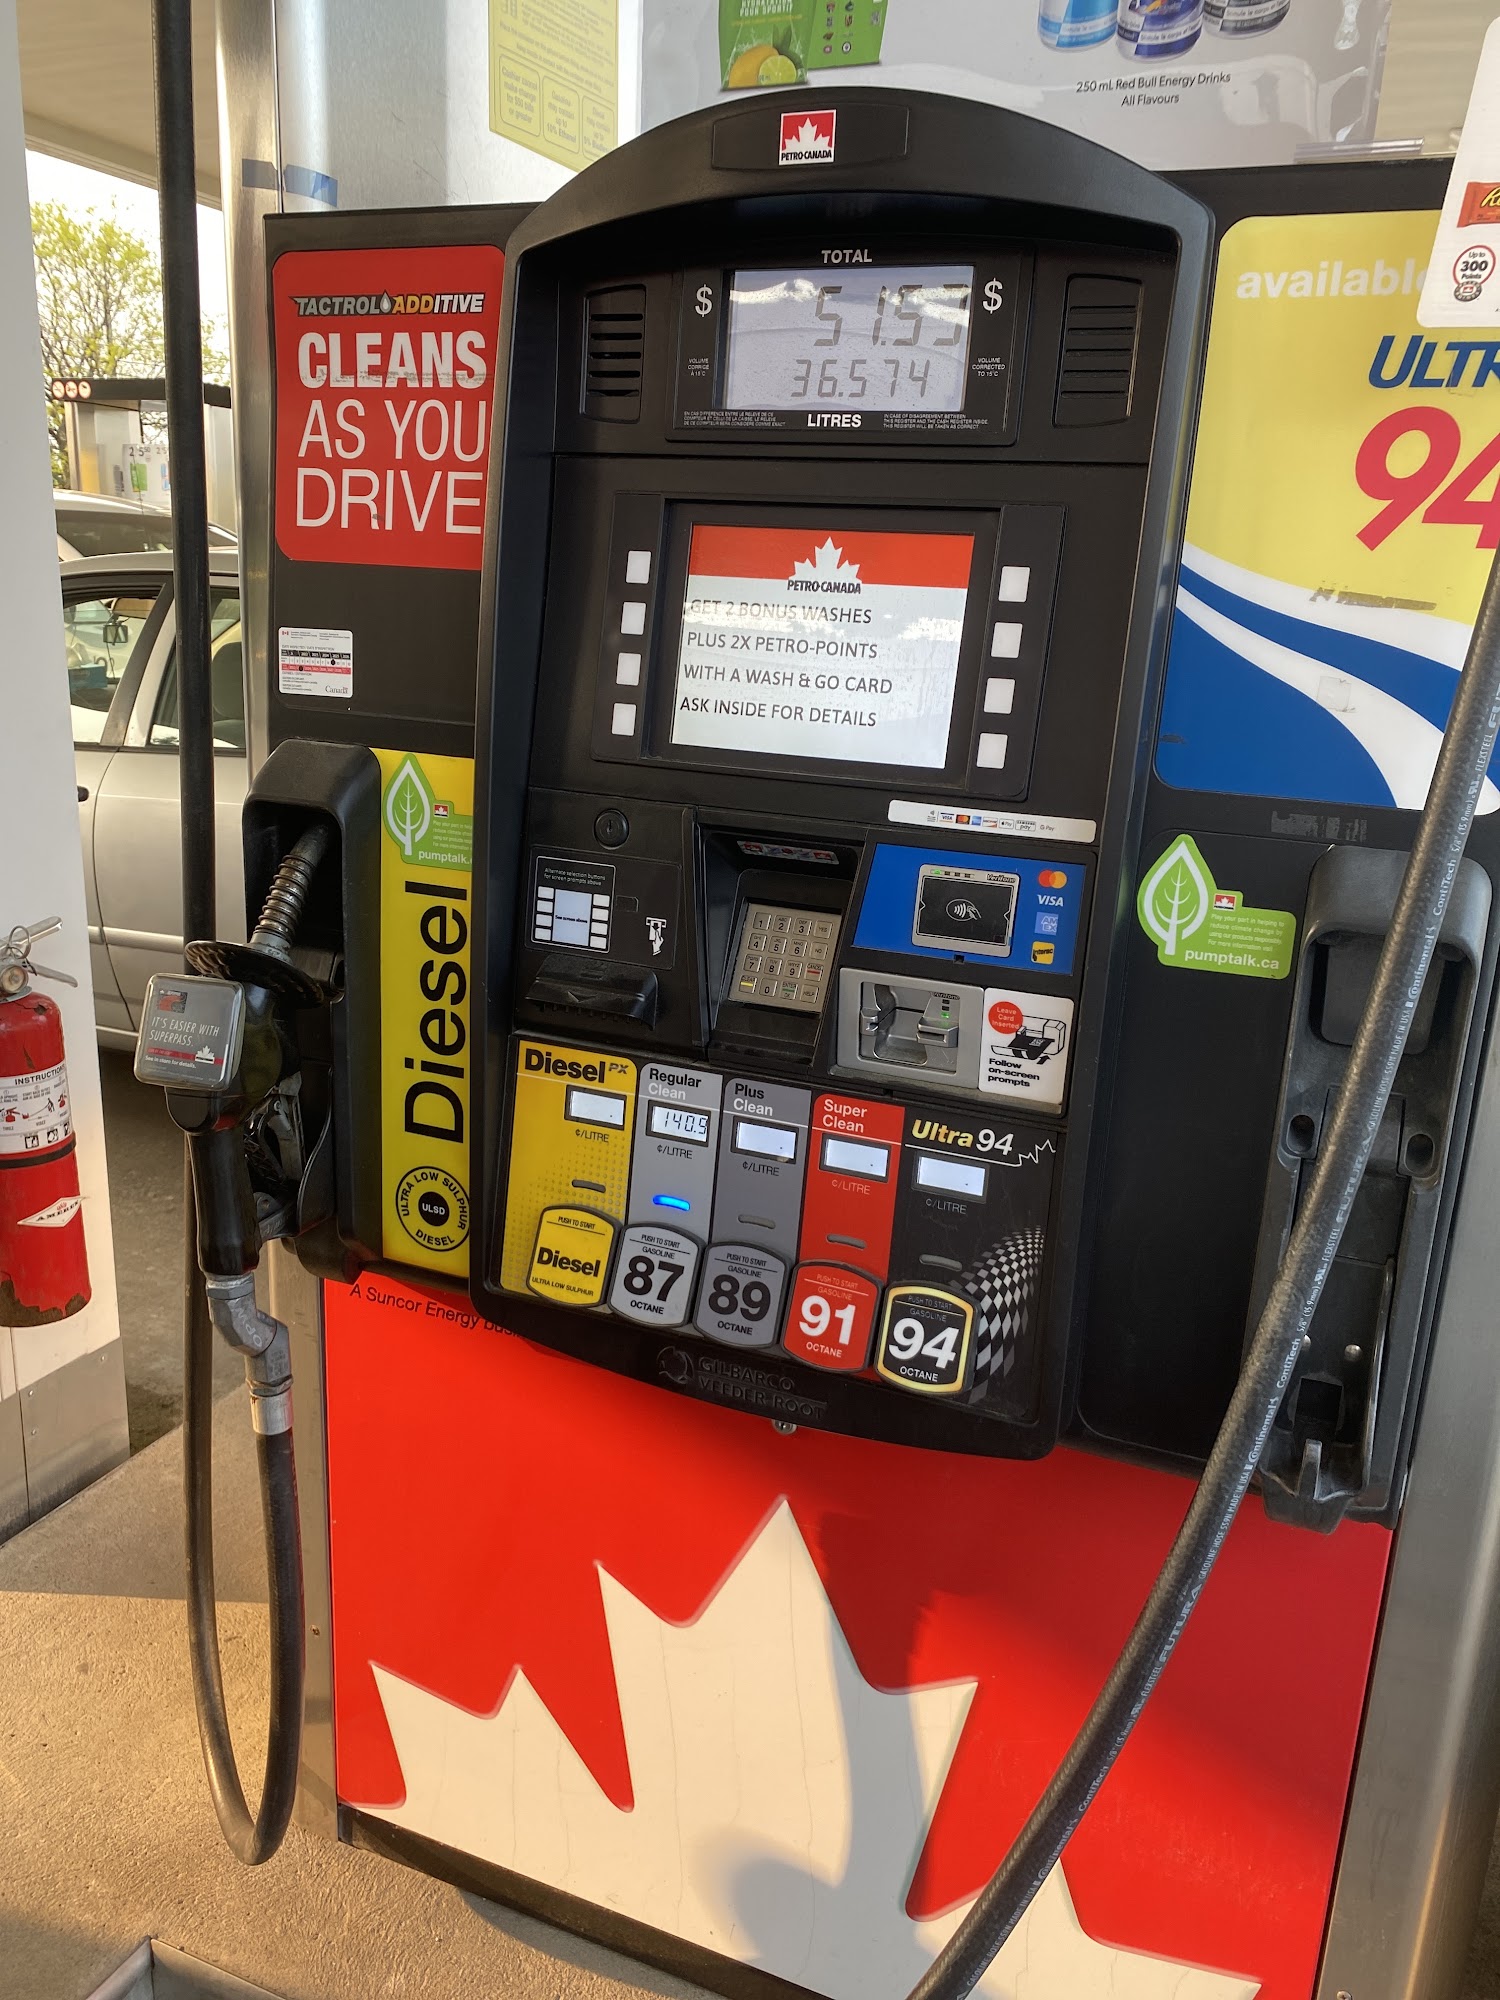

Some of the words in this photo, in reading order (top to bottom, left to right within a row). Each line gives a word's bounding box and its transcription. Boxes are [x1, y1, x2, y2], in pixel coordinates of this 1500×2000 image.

[1076, 80, 1097, 93] 250
[1099, 80, 1113, 92] mL
[1115, 78, 1136, 90] Red
[1137, 76, 1157, 88] Bull
[1159, 75, 1195, 88] Energy
[1197, 71, 1231, 85] Drinks
[1121, 95, 1135, 107] All
[1137, 93, 1180, 105] Flavours
[821, 249, 873, 264] TOTAL
[1460, 260, 1489, 272] 300
[294, 297, 380, 316] TACTROL
[392, 293, 485, 314] ADDITIVE
[694, 284, 713, 317] $
[982, 277, 1004, 314] $
[298, 330, 487, 389] CLEANS
[790, 358, 930, 398] 36.574
[298, 398, 366, 459] AS
[384, 399, 486, 462] YOU
[807, 413, 862, 429] LITRES
[1355, 405, 1500, 552] 94
[296, 467, 483, 534] DRIVE
[690, 598, 722, 615] GET
[726, 601, 734, 616] 2
[740, 602, 798, 619] BONUS
[801, 605, 873, 624] WASHES
[687, 631, 726, 648] PLUS
[730, 634, 751, 650] 2X
[755, 636, 879, 660] PETRO-POINTS
[684, 663, 726, 682] WITH
[729, 667, 741, 682] A
[745, 668, 793, 687] WASH
[798, 673, 811, 689] &
[814, 674, 840, 690] GO
[844, 676, 893, 694] CARD
[680, 697, 709, 713] ASK
[713, 699, 766, 719] INSIDE
[771, 702, 804, 721] FOR
[808, 705, 878, 727] DETAILS
[1408, 930, 1435, 1000] Continental
[1433, 858, 1457, 917] ContiTech
[1475, 733, 1494, 773] FLEXSTEEL
[1037, 894, 1063, 907] VISA
[1253, 927, 1275, 936] change
[1185, 949, 1280, 970] pumptalk.ca
[404, 880, 468, 1144] Diesel
[996, 1007, 1017, 1015] Leave
[998, 1013, 1015, 1022] Card
[151, 1016, 167, 1028] IT'S
[169, 1019, 197, 1034] EASIER
[199, 1023, 220, 1037] WITH
[992, 1020, 1020, 1030] Inserted
[149, 1029, 194, 1047] SUPERPASS.
[525, 1048, 606, 1084] Diesel
[608, 1062, 629, 1075] PX
[989, 1058, 1022, 1069] Follow
[649, 1067, 702, 1088] Regular
[988, 1067, 1040, 1080] on-screen
[988, 1075, 1030, 1087] prompts
[648, 1083, 686, 1100] Clean
[734, 1083, 765, 1099] Plus
[733, 1098, 773, 1117] Clean
[823, 1098, 868, 1119] Super
[822, 1114, 864, 1133] Clean
[575, 1129, 610, 1142] ¢/LITRE
[657, 1144, 693, 1160] ¢/LITRE
[742, 1161, 779, 1177] ¢/LITRE
[400, 1181, 415, 1217] ULTRA
[413, 1171, 440, 1183] LOW
[442, 1177, 468, 1231] SULPHUR
[421, 1202, 446, 1216] ULSD
[557, 1216, 571, 1225] PUSH
[572, 1219, 580, 1227] TO
[579, 1220, 597, 1231] START
[415, 1228, 455, 1246] DIESEL
[641, 1234, 655, 1244] PUSH
[656, 1237, 664, 1245] TO
[663, 1238, 681, 1249] START
[537, 1246, 602, 1278] Diesel
[642, 1246, 676, 1260] GASOLINE
[726, 1252, 741, 1262] PUSH
[741, 1255, 750, 1264] TO
[749, 1257, 768, 1268] START
[623, 1255, 686, 1303] 87
[727, 1265, 762, 1279] GASOLINE
[816, 1273, 832, 1283] PUSH
[832, 1276, 841, 1285] TO
[840, 1278, 859, 1290] START
[531, 1275, 551, 1287] ULTRA
[551, 1280, 565, 1290] LOW
[565, 1283, 594, 1297] SULPHUR
[817, 1286, 853, 1301] GASOLINE
[350, 1283, 362, 1300] A
[366, 1285, 423, 1314] Suncor
[425, 1300, 481, 1330] Energy
[630, 1299, 665, 1315] OCTANE
[708, 1273, 772, 1322] 89
[908, 1295, 925, 1305] PUSH
[925, 1298, 934, 1307] TO
[933, 1299, 953, 1311] START
[798, 1295, 857, 1346] 91
[909, 1307, 948, 1323] GASOLINE
[717, 1320, 753, 1336] OCTANE
[805, 1341, 843, 1359] OCTANE
[888, 1317, 960, 1370] 94
[698, 1355, 796, 1392] GILBARCO
[899, 1365, 939, 1383] OCTANE
[698, 1374, 767, 1406] VEEDER
[771, 1393, 827, 1421] ROOT
[1159, 1583, 1203, 1664] FUTURA
[1199, 1548, 1218, 1580] GASOLINE
[1213, 1529, 1226, 1549] HOSE
[1227, 1492, 1241, 1514] MADE
[1235, 1483, 1243, 1494] IN
[1239, 1470, 1250, 1484] USA
[1248, 1402, 1277, 1463] Continental
[1276, 1338, 1301, 1389] ContiTech
[1322, 1227, 1341, 1263] FLEXSTEEL
[1037, 1824, 1074, 1881] Continental
[1078, 1765, 1110, 1813] ContiTech
[1140, 1665, 1164, 1698] FLEXSTEEL
